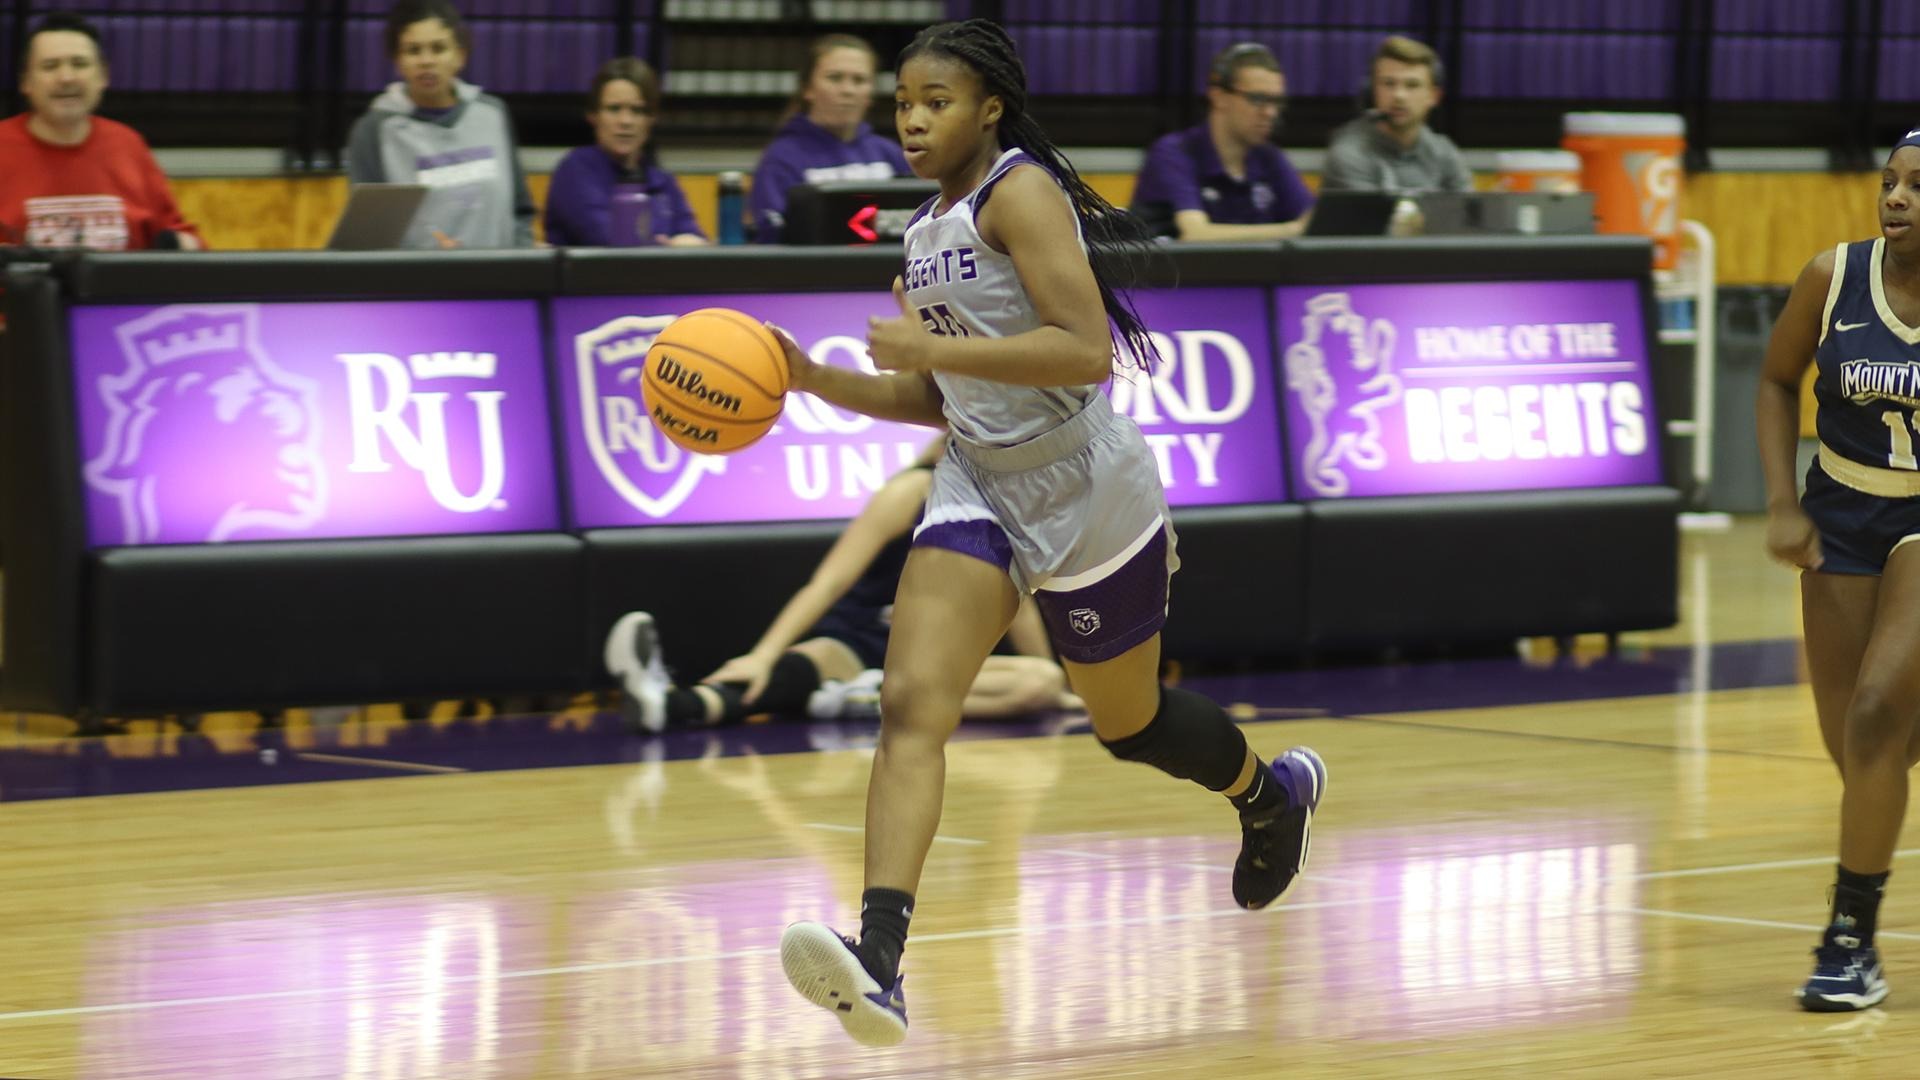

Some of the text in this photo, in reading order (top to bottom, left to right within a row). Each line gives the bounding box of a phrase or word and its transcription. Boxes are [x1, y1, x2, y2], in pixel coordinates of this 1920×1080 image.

[905, 248, 979, 294] EGENTS
[1414, 322, 1619, 362] HOME OF THE
[656, 353, 743, 416] Wilson
[1844, 363, 1910, 397] MOUNT
[334, 352, 507, 512] RU
[653, 404, 720, 444] NCAA
[1404, 381, 1648, 464] REGENTS
